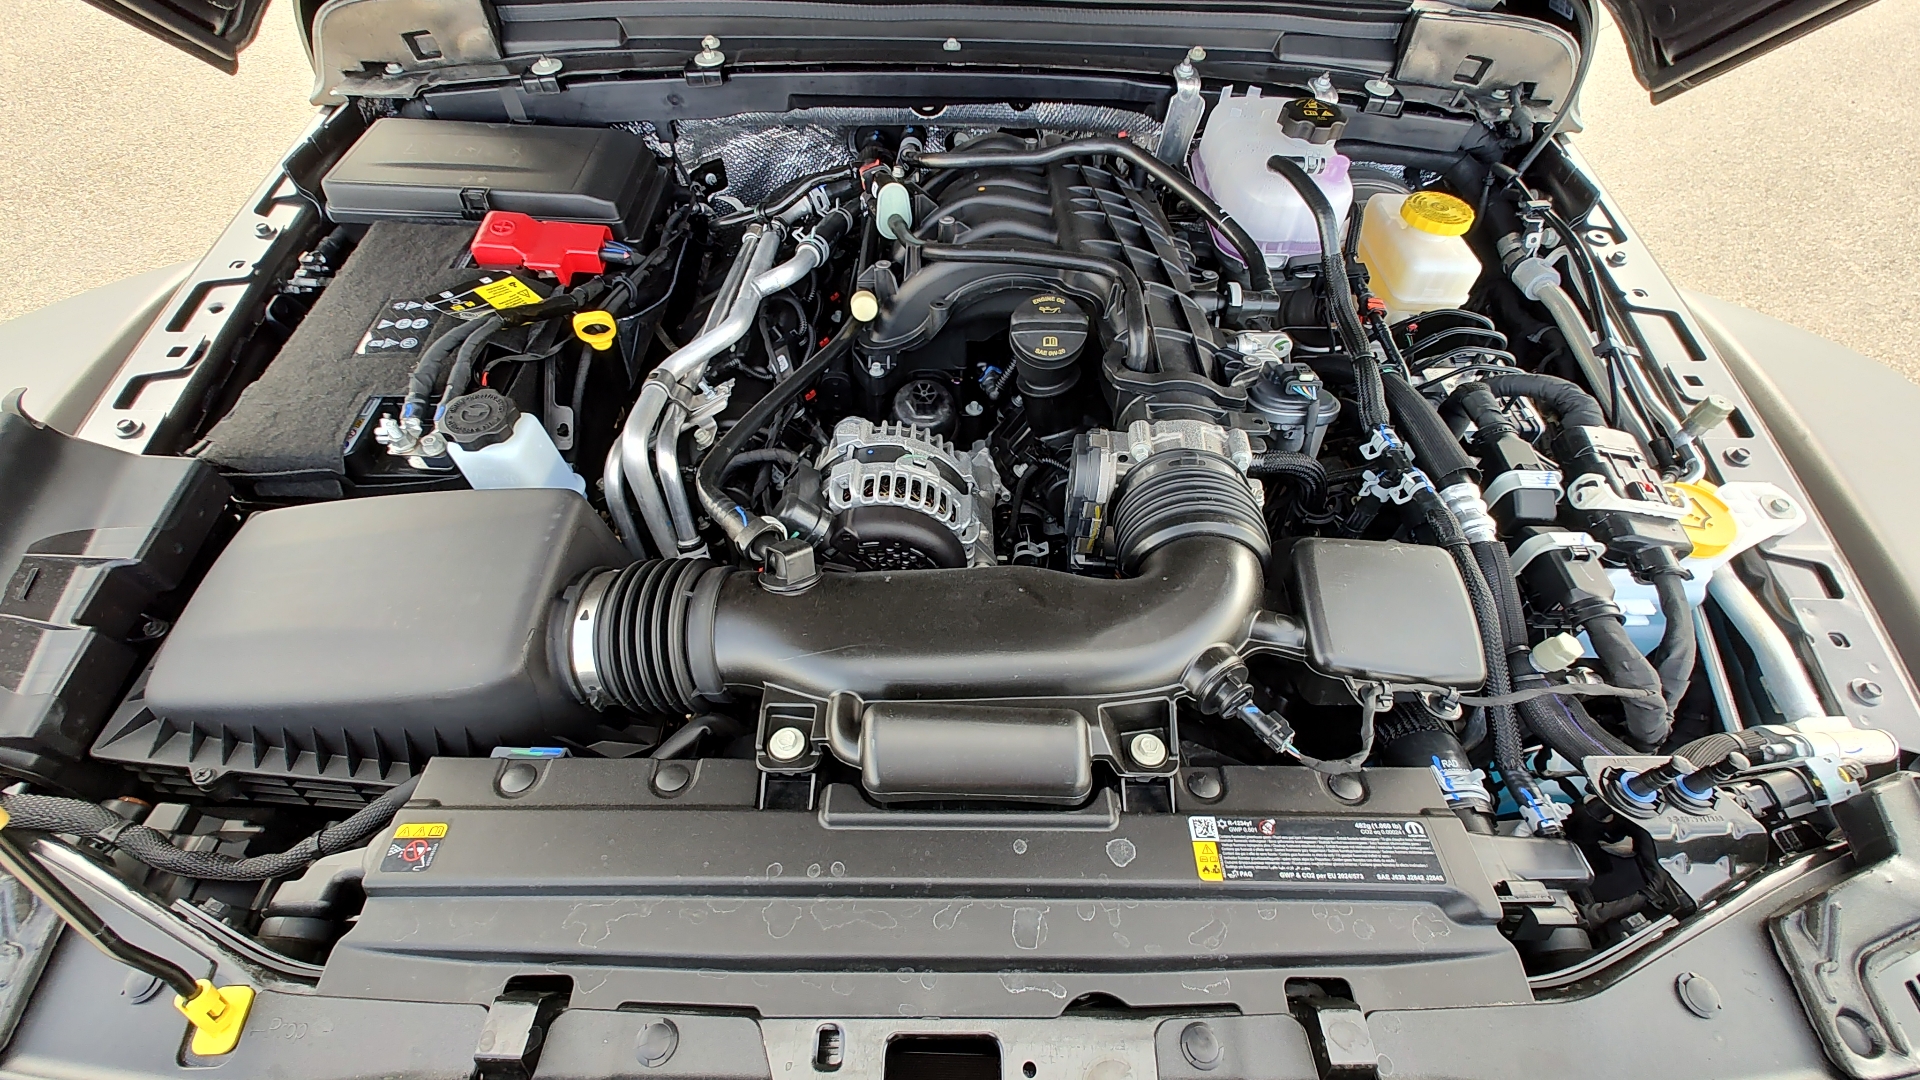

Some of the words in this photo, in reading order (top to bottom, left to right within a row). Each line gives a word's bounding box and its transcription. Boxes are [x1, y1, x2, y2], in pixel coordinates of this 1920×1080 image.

[1032, 296, 1055, 305] ENGINE
[1056, 297, 1066, 305] OIL
[1034, 348, 1048, 356] SAE
[1441, 759, 1458, 768] RAD
[1240, 870, 1253, 878] PAG
